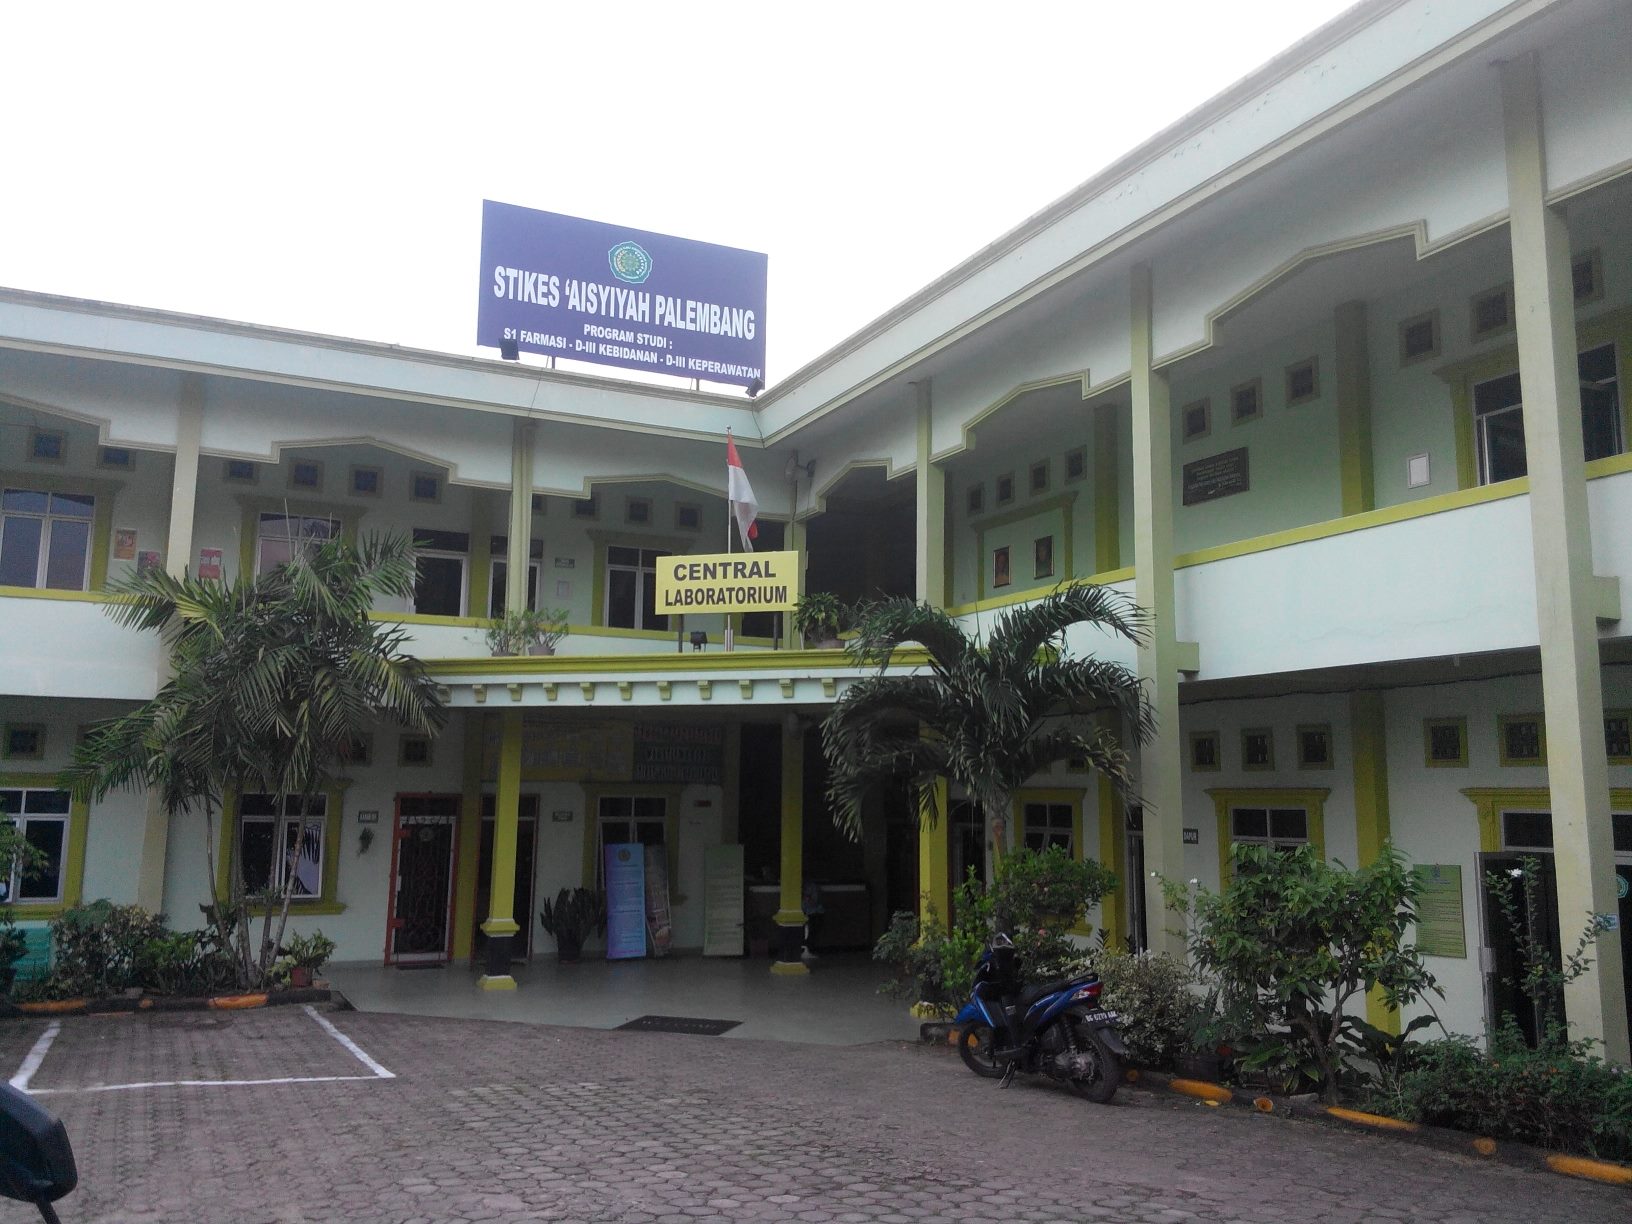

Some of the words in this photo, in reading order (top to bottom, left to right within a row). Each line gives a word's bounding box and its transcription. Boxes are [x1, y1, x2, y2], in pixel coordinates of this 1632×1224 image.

[494, 265, 560, 308] STIKES
[655, 294, 755, 340] PALEMBANG
[584, 323, 634, 344] PROGRAM
[637, 333, 667, 349] STUDI
[503, 327, 517, 340] S1
[520, 330, 567, 349] FARMASI
[575, 339, 596, 354] D-III
[599, 343, 658, 364] KEBIDANAN
[666, 354, 686, 368] D-III
[688, 357, 761, 379] KEPERAWATAN
[673, 560, 777, 582] CENTRAL
[665, 585, 788, 607] LABORATORIUM
